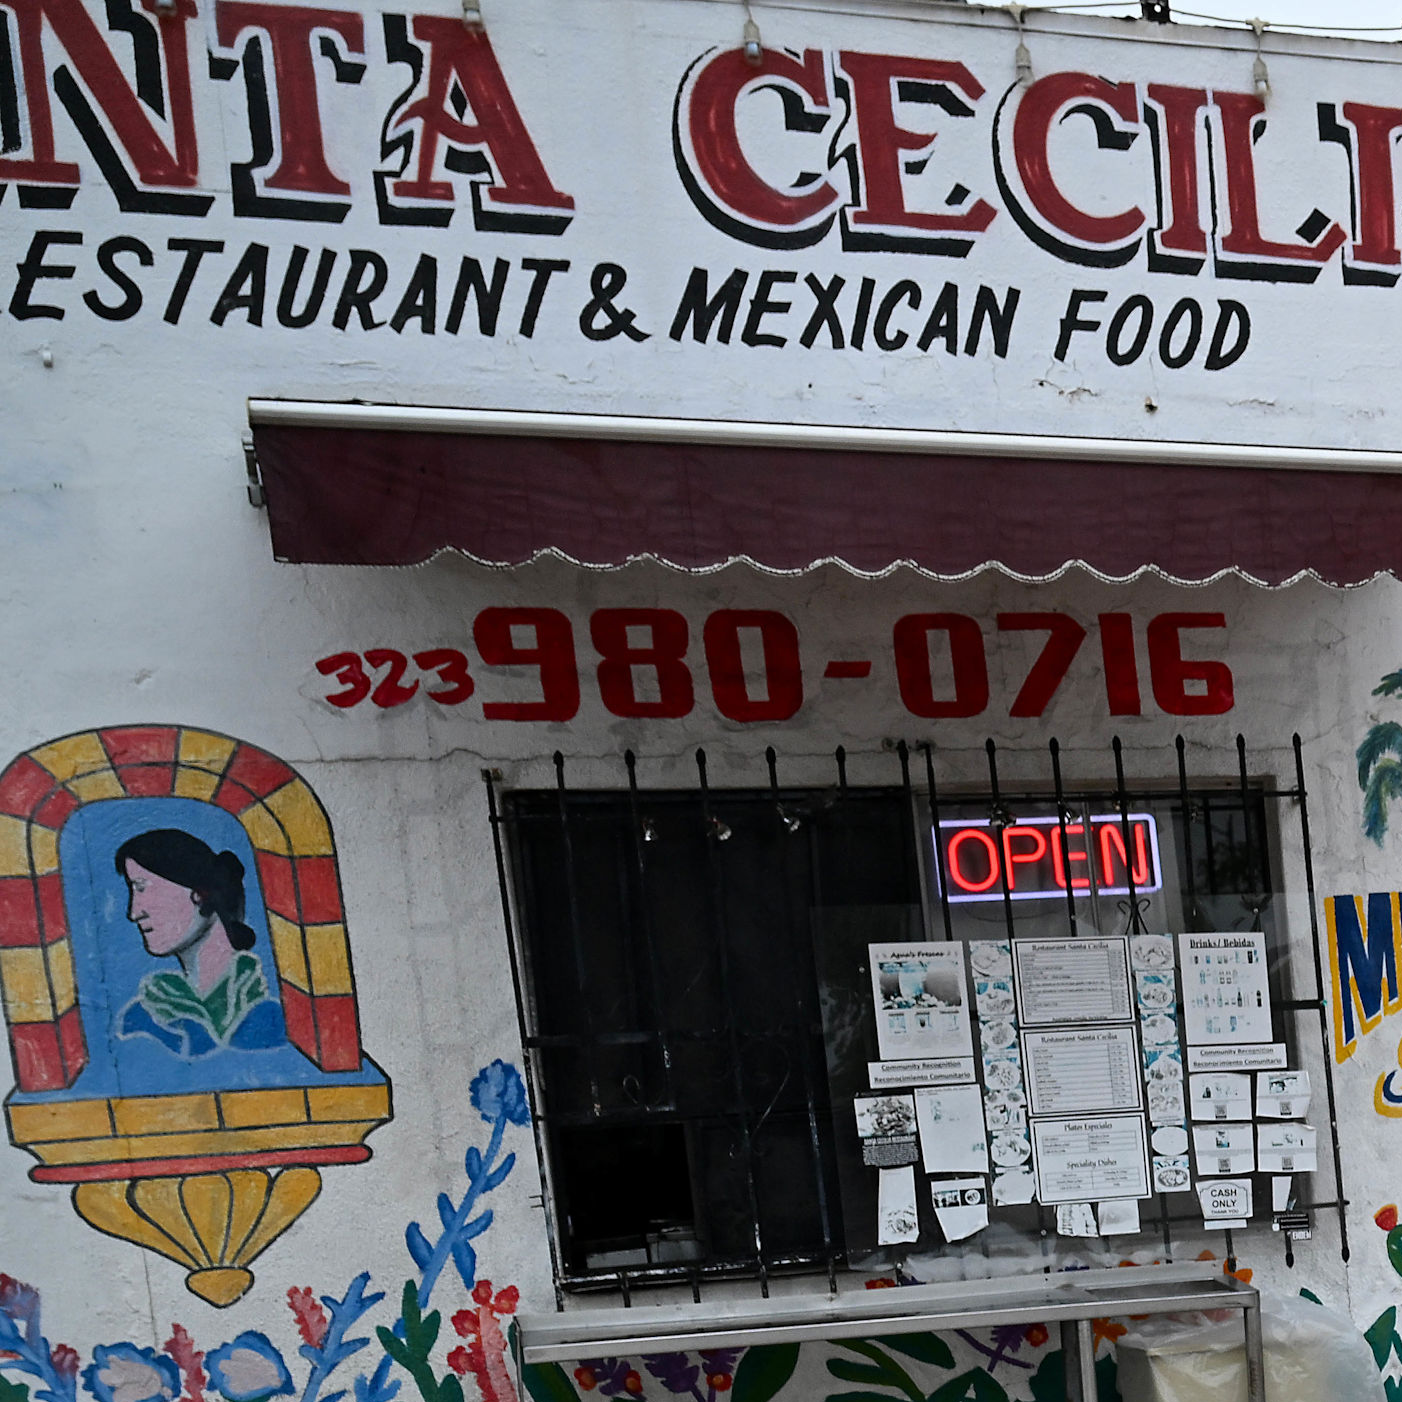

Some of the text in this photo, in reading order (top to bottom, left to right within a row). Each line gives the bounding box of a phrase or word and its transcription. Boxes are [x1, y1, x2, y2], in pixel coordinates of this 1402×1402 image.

[0, 231, 1252, 370] ESTAURANT & MEXICAN FOOD
[316, 606, 1235, 723] 323 980-0716
[948, 822, 1149, 892] OPEN
[1224, 938, 1255, 948] Bebidas
[1200, 1047, 1273, 1057] Community Recognition
[881, 1061, 961, 1072] Community Recognition
[1244, 1058, 1282, 1066] Comunitario
[874, 1072, 971, 1083] Reconocimiento Comunitario
[1211, 1189, 1237, 1197] CASH
[1212, 1200, 1237, 1208] ONLY
